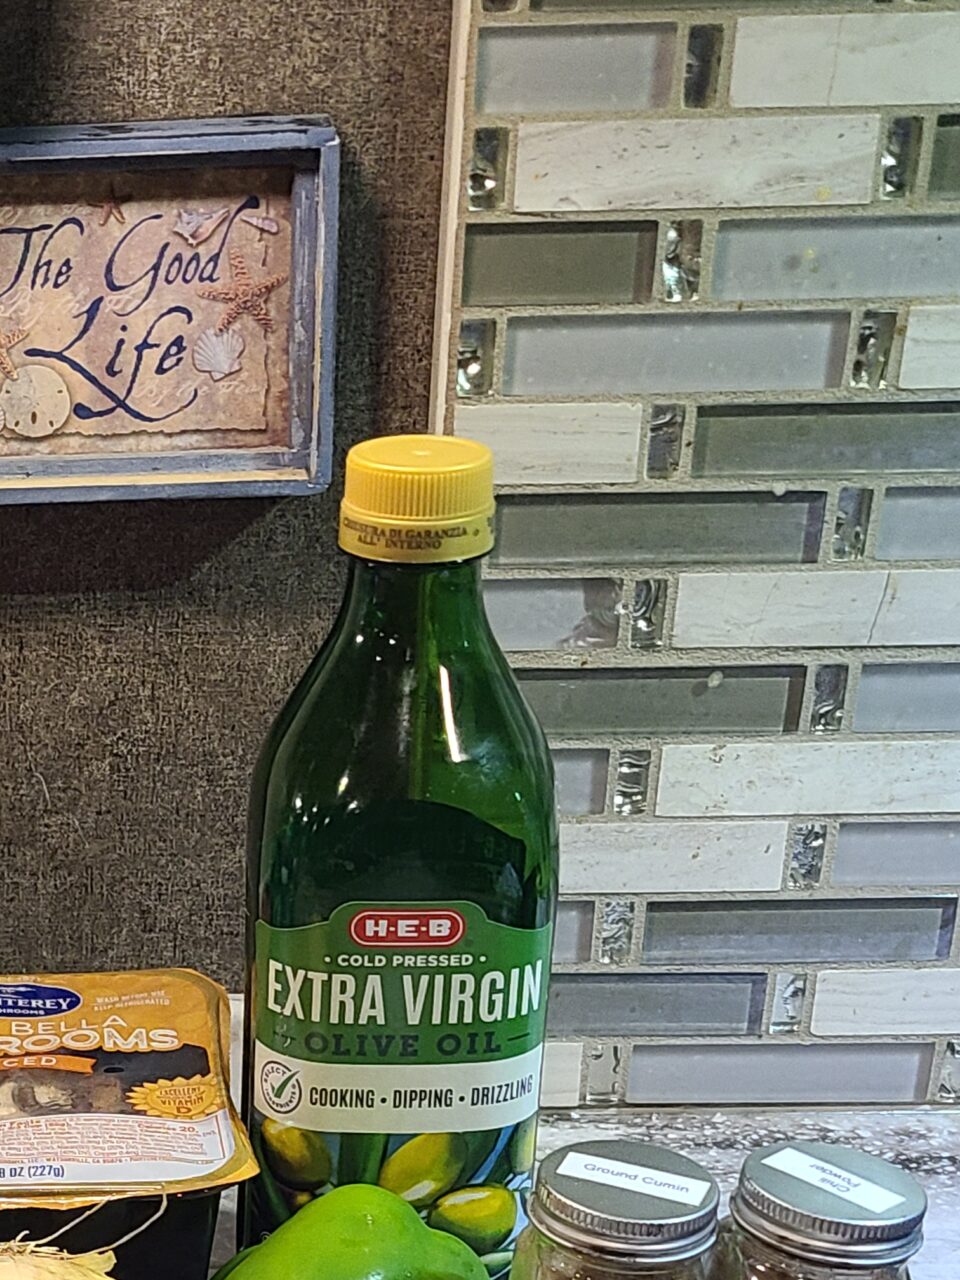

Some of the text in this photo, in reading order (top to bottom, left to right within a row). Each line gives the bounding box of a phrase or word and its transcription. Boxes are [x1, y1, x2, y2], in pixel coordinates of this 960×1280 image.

[104, 195, 260, 317] Good
[24, 295, 198, 423] Life
[390, 527, 402, 538] DI
[405, 526, 468, 540] GARANZIA
[384, 538, 442, 550] INTERNO
[337, 954, 474, 968] COLD PRESSED
[267, 958, 543, 1026] EXTRA VIRGIN
[11, 1015, 129, 1036] BELLA
[304, 1031, 502, 1057] OLIVE OIL
[159, 1086, 202, 1096] EXCELLENT
[309, 1074, 533, 1109] COOKING DIPPING DRIZZLING
[160, 1096, 205, 1106] VITAMIN
[175, 1106, 193, 1114] D
[9, 1166, 25, 1177] OZ
[583, 1163, 690, 1194] Ground Cumin
[809, 1163, 861, 1188] Powder
[818, 1177, 850, 1193] Chili
